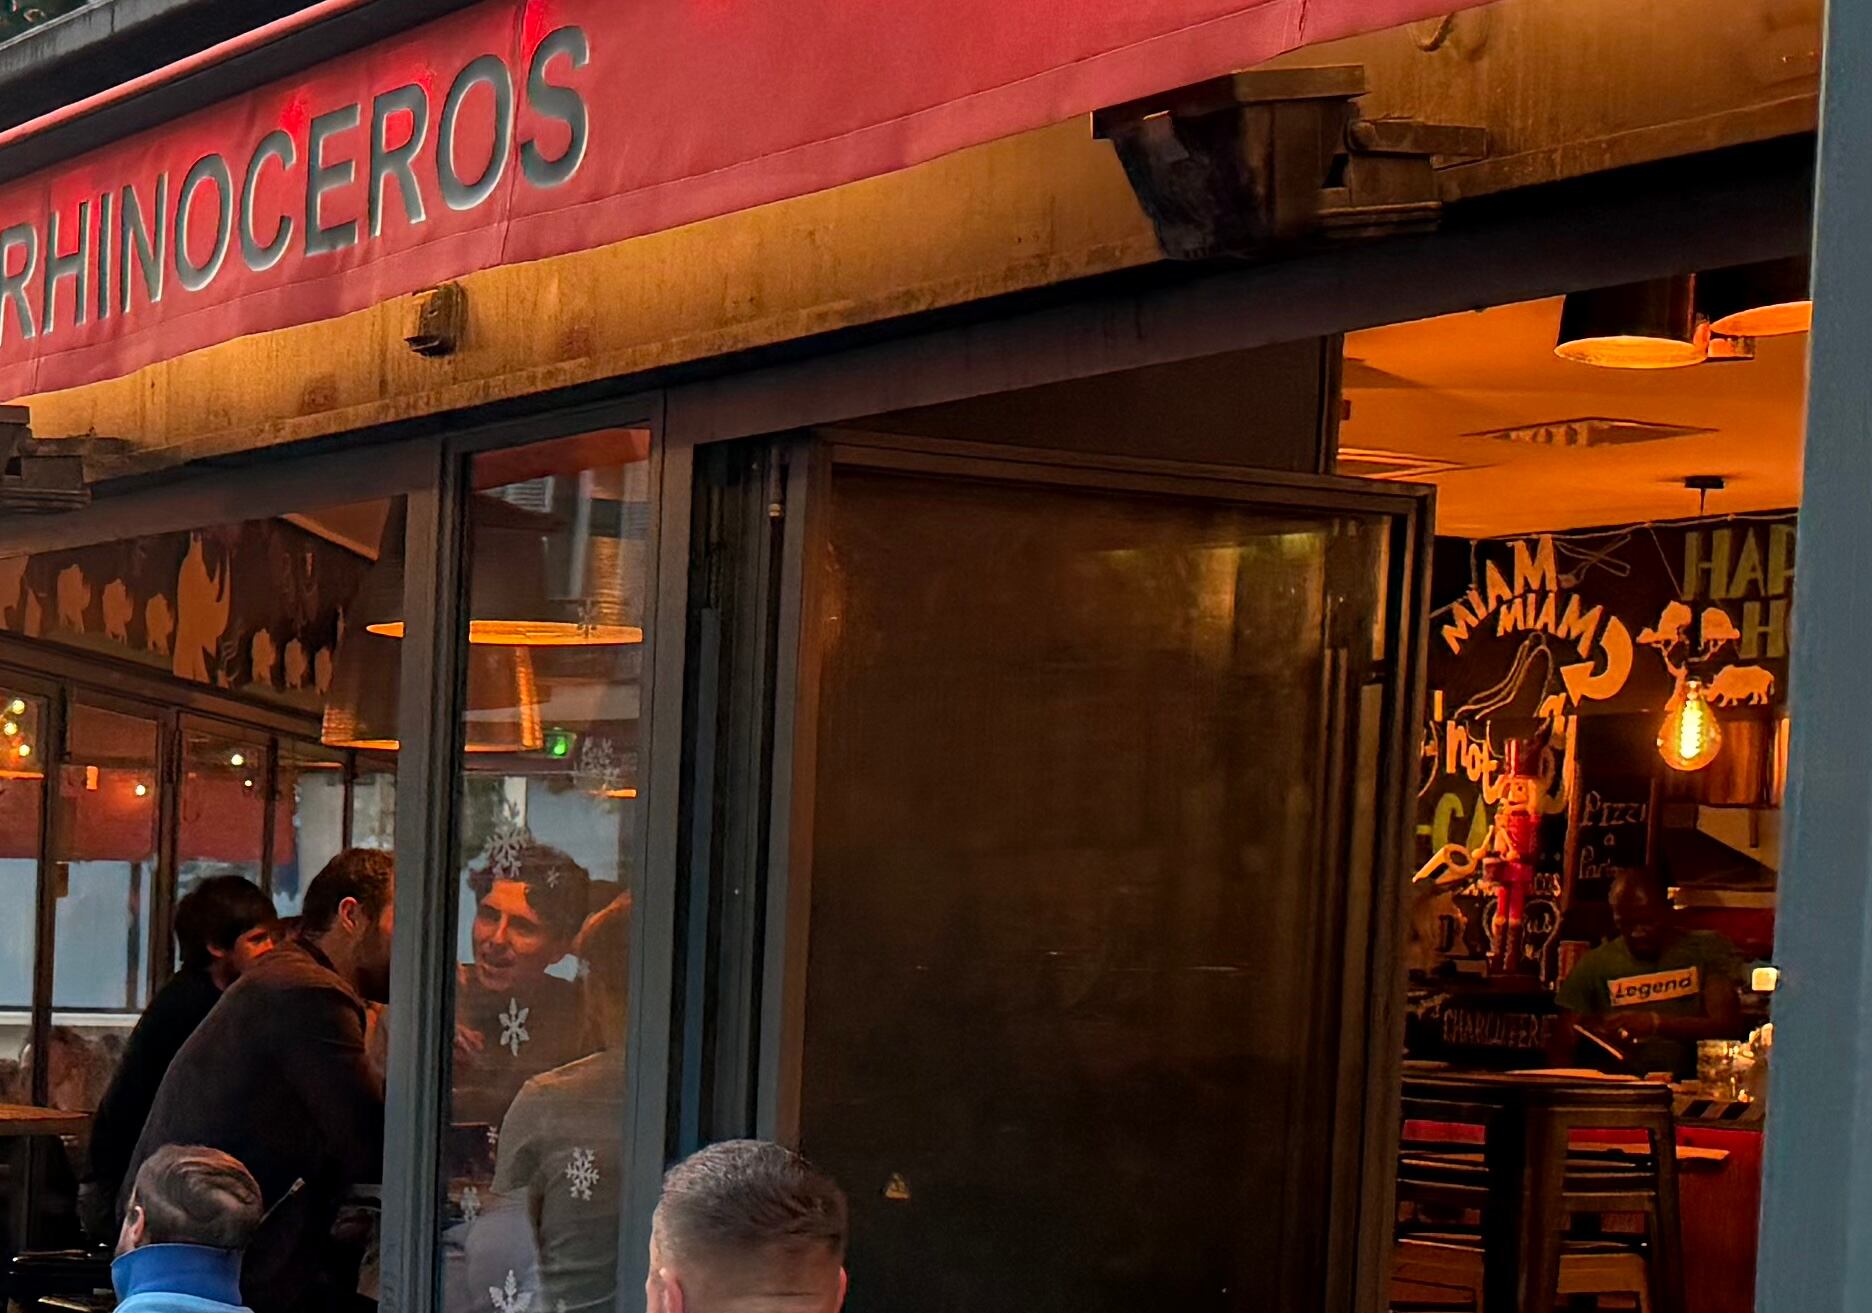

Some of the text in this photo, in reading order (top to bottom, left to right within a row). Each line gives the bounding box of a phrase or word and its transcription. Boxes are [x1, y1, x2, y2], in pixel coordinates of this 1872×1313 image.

[1441, 533, 1558, 655] MIAM
[1496, 592, 1604, 659] MIAM
[1614, 971, 1693, 1000] Legend
